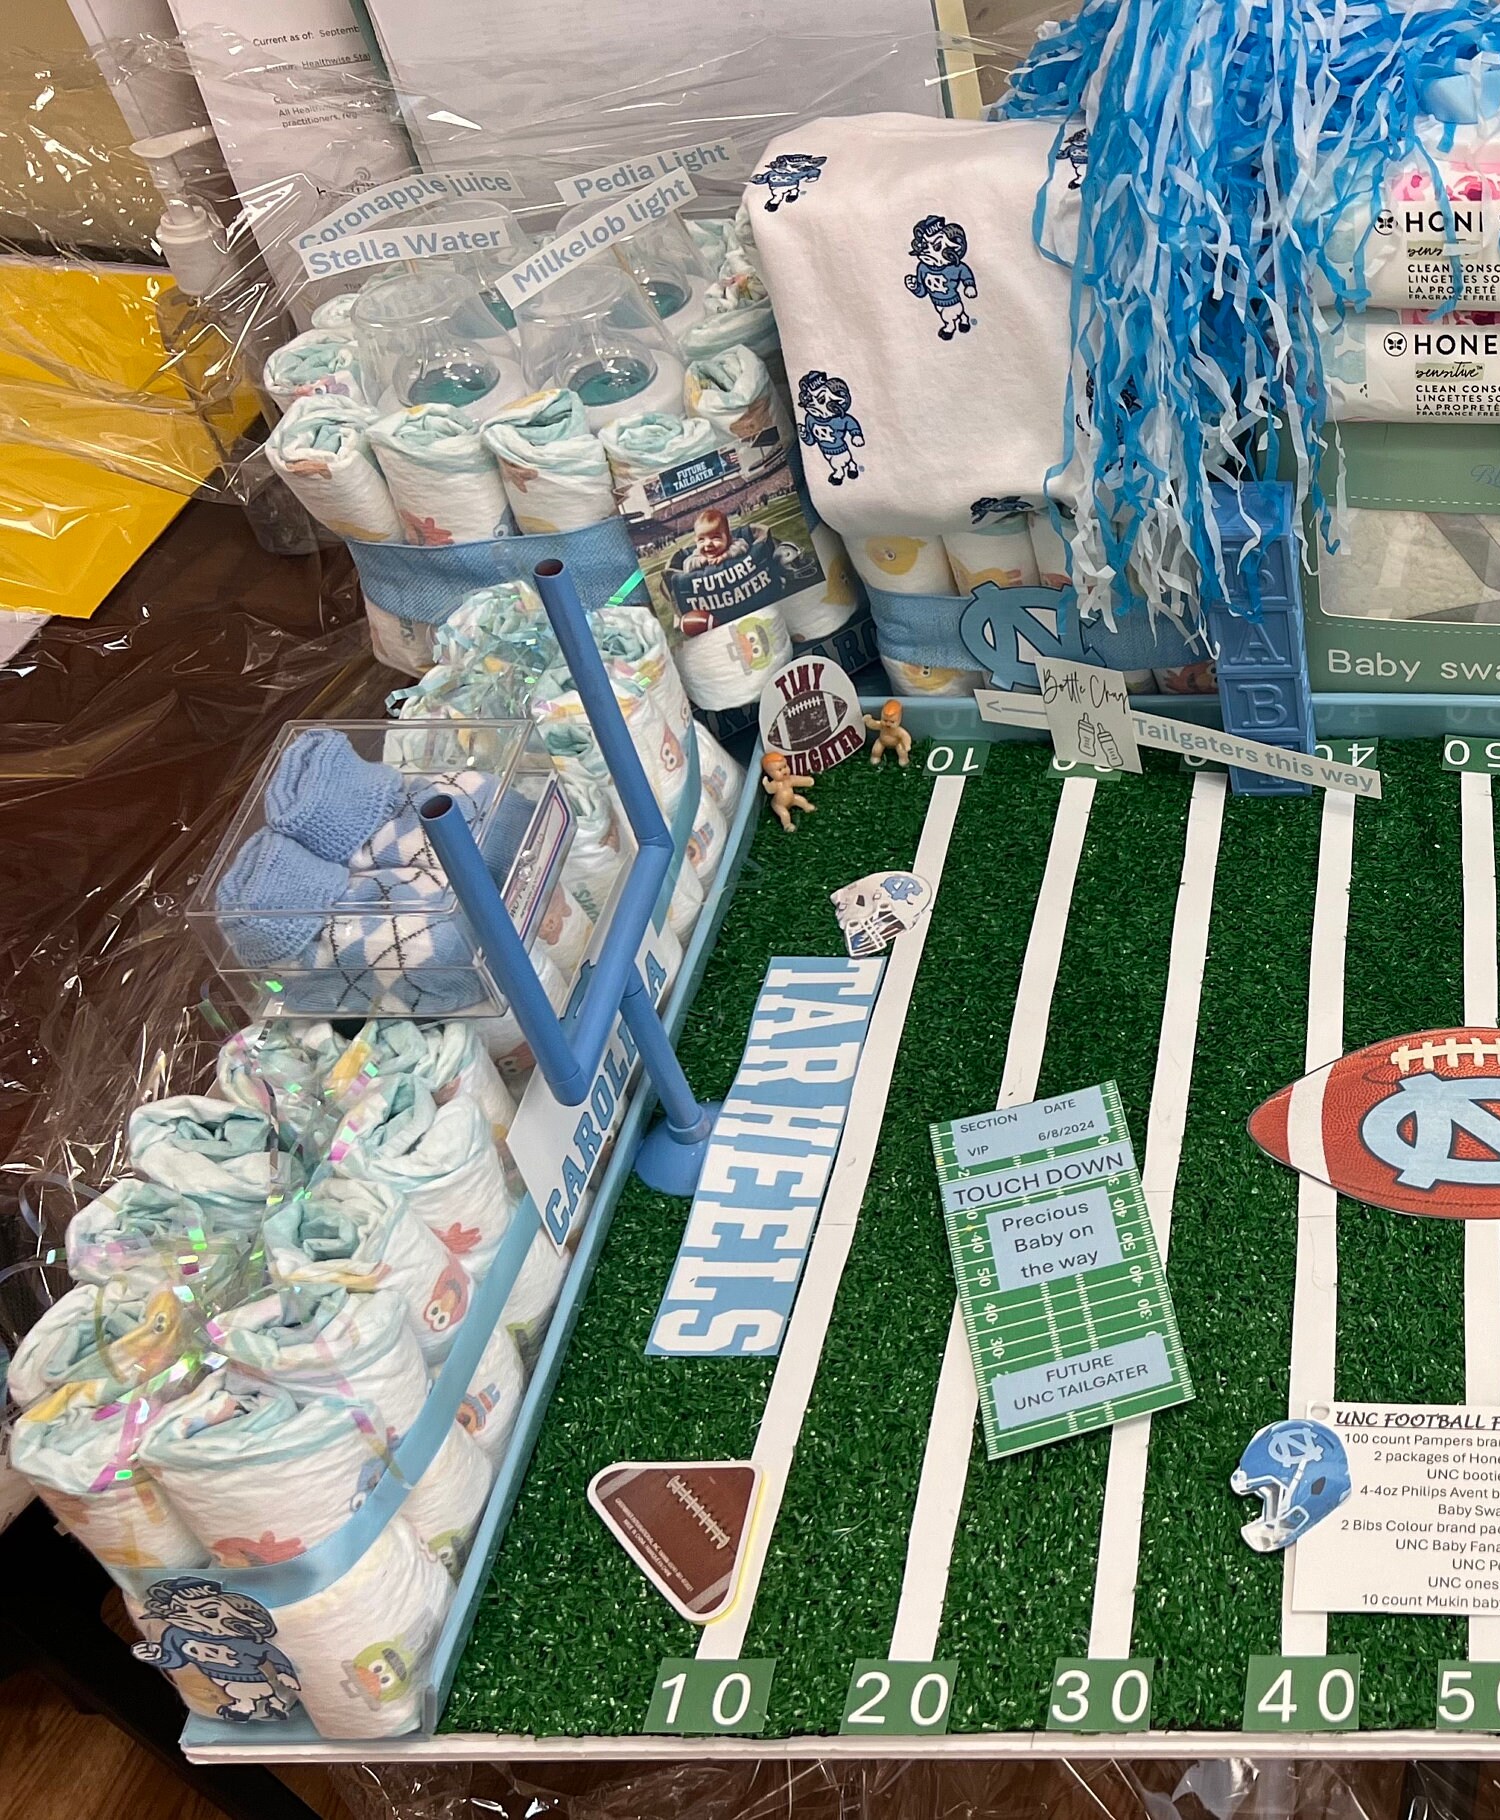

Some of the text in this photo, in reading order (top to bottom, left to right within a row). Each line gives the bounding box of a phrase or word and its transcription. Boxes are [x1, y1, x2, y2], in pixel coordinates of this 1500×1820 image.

[252, 35, 288, 48] Current
[289, 33, 300, 42] as
[301, 56, 351, 70] Healthwise
[575, 144, 730, 201] Pedia Light
[299, 174, 445, 250] Coronapple
[445, 173, 512, 199] juice
[308, 229, 501, 276] Stella Water
[508, 178, 692, 296] Milkelob light
[1408, 263, 1451, 273] CLEAN
[1416, 384, 1457, 393] CLEAN
[1416, 394, 1482, 403] LINGETTES
[1436, 402, 1500, 412] PROPRETÉ
[691, 555, 757, 595] FUTURE
[686, 571, 773, 611] TAILGATER
[1328, 649, 1421, 683] Baby
[774, 662, 825, 702] TINY
[1041, 668, 1087, 706] Bottle
[926, 745, 981, 773] 10
[1132, 716, 1258, 764] Tailgaters
[1264, 749, 1314, 777] this
[1320, 767, 1374, 794] way
[735, 958, 885, 1087] TAR
[544, 951, 667, 1247] CAROLIA
[960, 1099, 1077, 1134] SECTION DATE
[967, 1120, 1095, 1157] VIP 6/8/2024
[953, 1152, 1125, 1206] TOUCH DOWN
[652, 1097, 847, 1353] HEELS
[1001, 1201, 1090, 1232] Precious
[1014, 1223, 1094, 1254] Baby on
[1021, 1250, 1099, 1279] the way
[1046, 1354, 1115, 1383] FUTURE
[1013, 1363, 1149, 1412] UNC TAILGATER
[1335, 1410, 1379, 1426] UNC
[1384, 1413, 1486, 1429] FOOTBALL
[1344, 1433, 1369, 1444] 100
[1372, 1434, 1411, 1445] count
[1414, 1434, 1473, 1448] Pampers
[1385, 1451, 1449, 1465] packages
[1452, 1453, 1466, 1463] of
[1427, 1469, 1460, 1480] UNC
[1360, 1485, 1398, 1496] 4-4oz
[1401, 1485, 1447, 1499] Philips
[1450, 1487, 1488, 1499] Avent
[1438, 1503, 1472, 1518] Baby
[1353, 1519, 1383, 1531] Bibs
[1385, 1520, 1433, 1532] Colour
[1436, 1521, 1476, 1534] brand
[1395, 1538, 1429, 1551] UNC
[1432, 1539, 1467, 1553] Baby
[1452, 1558, 1486, 1571] UNC
[178, 1584, 218, 1601] UNC
[1428, 1576, 1462, 1589] UNC
[1362, 1594, 1378, 1605] 10
[1381, 1594, 1422, 1606] count
[1426, 1595, 1469, 1608] Mukin
[660, 1669, 753, 1727] 10
[846, 1669, 951, 1727] 20
[1051, 1668, 1150, 1725] 30
[1256, 1668, 1357, 1725] 40
